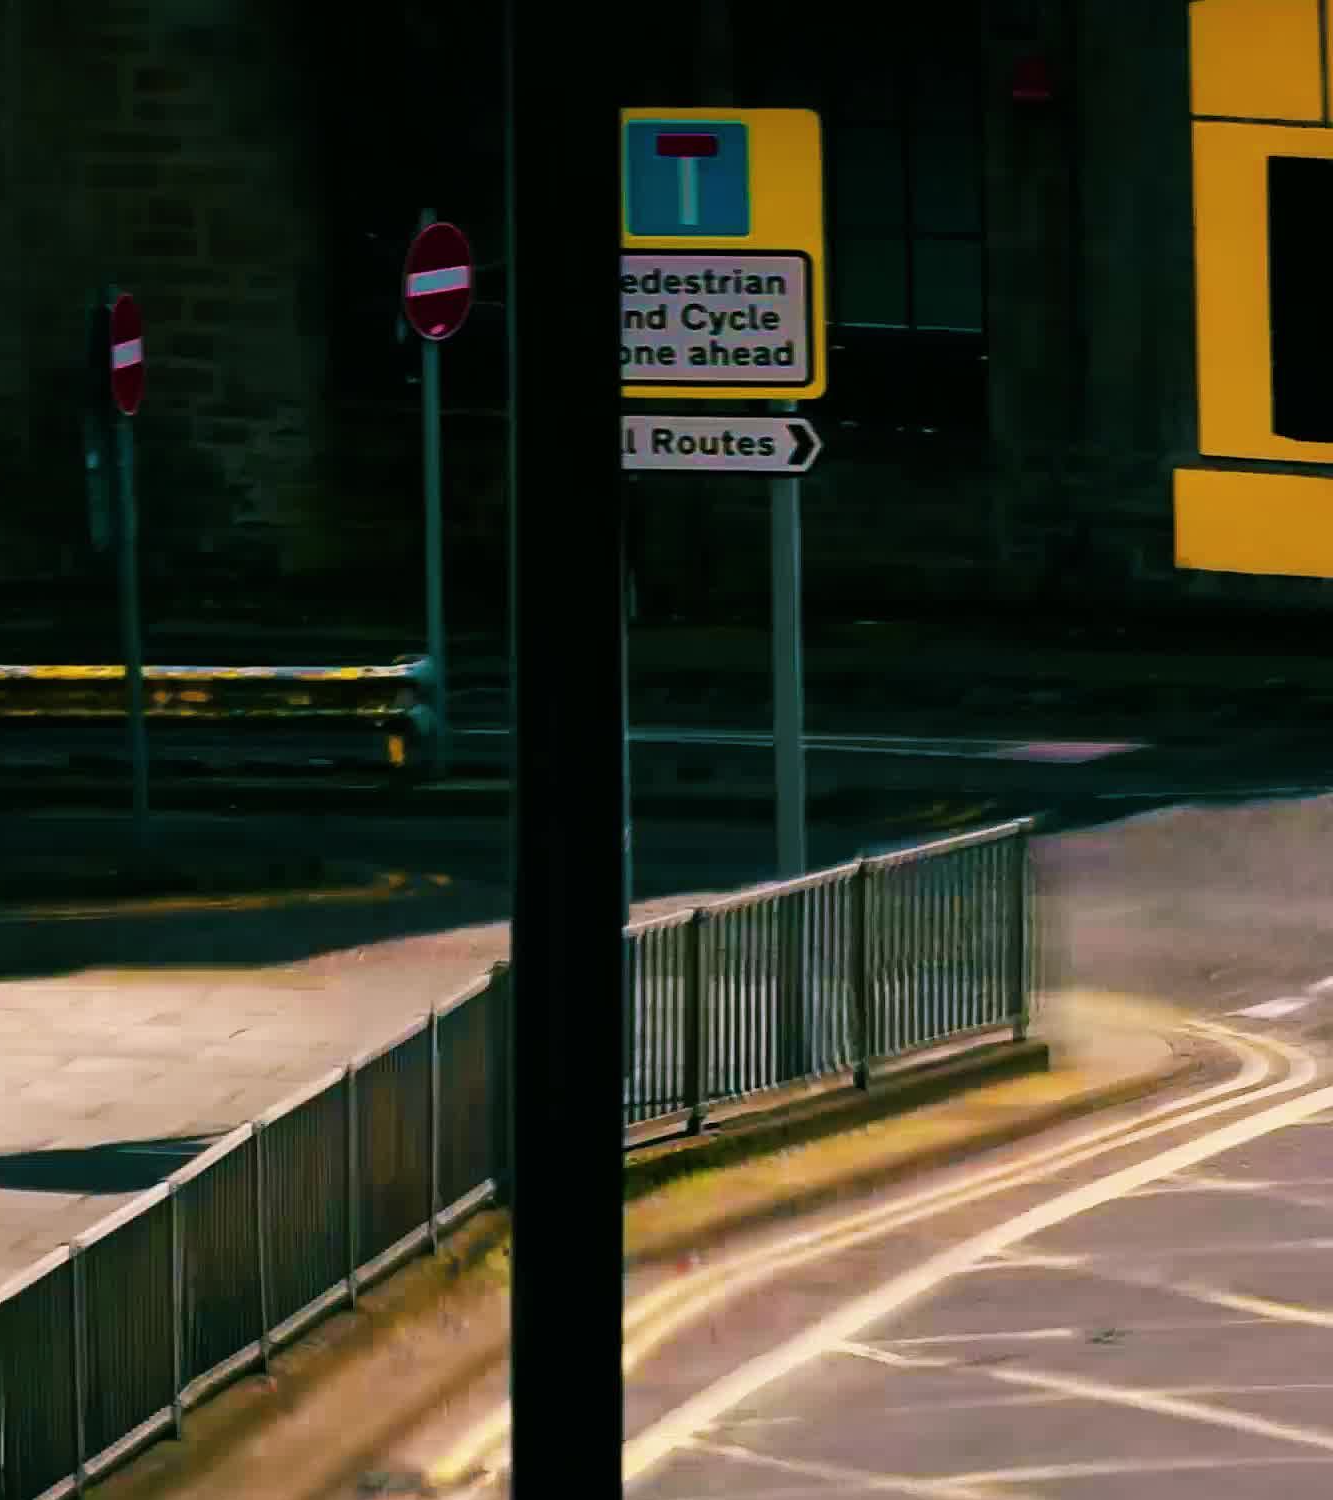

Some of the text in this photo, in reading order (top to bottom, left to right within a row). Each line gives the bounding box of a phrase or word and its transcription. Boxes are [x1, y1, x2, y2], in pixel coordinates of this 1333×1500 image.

[621, 268, 787, 296] edestrian
[624, 303, 782, 336] nd Cycle
[620, 339, 795, 367] one ahead
[651, 427, 776, 457] Routes
